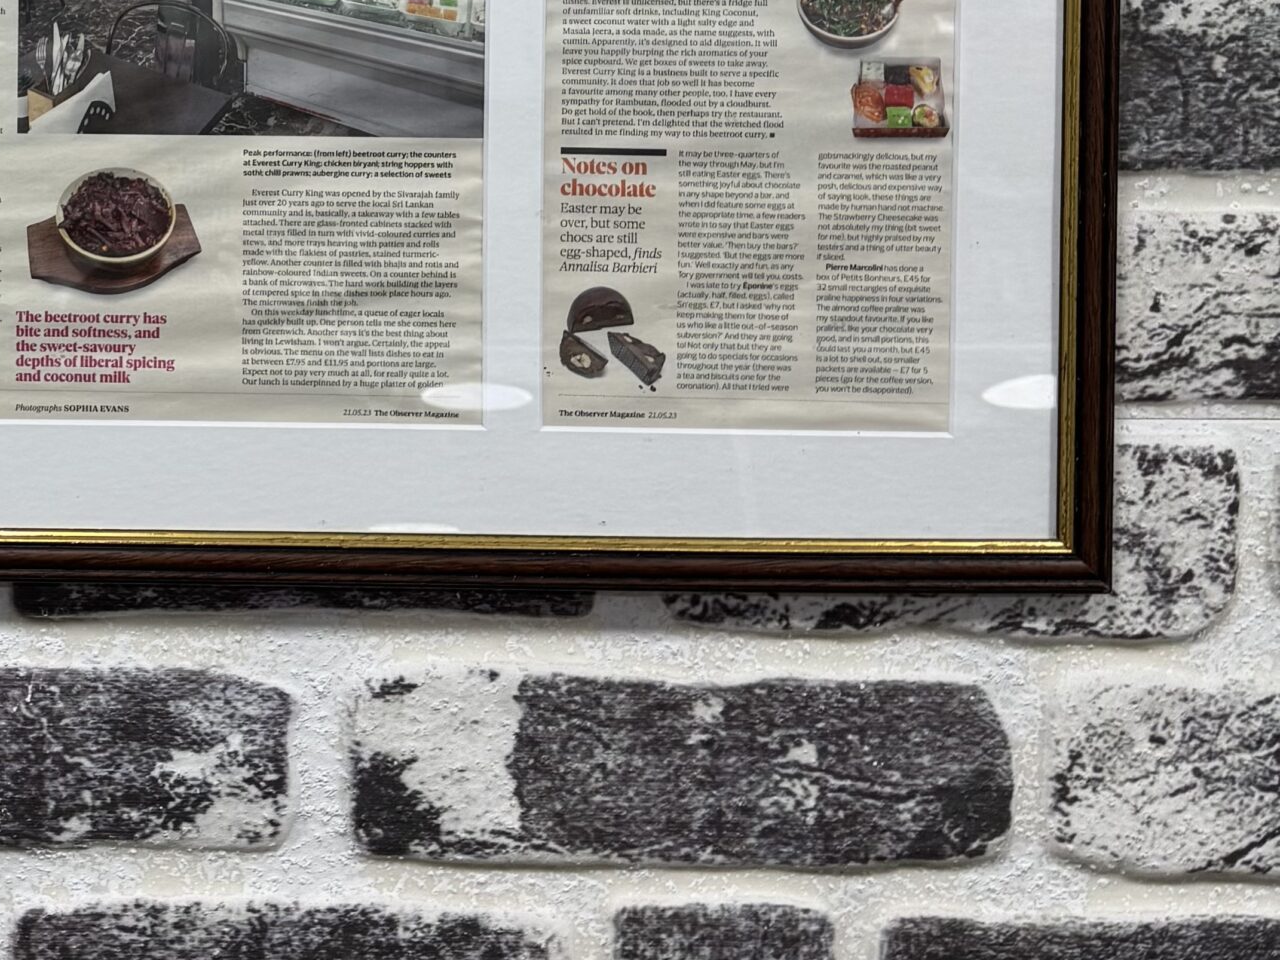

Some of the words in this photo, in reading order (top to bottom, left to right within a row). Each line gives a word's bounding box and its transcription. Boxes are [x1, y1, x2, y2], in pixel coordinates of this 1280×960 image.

[243, 149, 262, 158] Peak
[313, 150, 335, 159] (from
[335, 150, 352, 159] left)
[352, 150, 386, 159] beetroot
[386, 152, 409, 161] curry;
[409, 151, 423, 159] the
[562, 157, 618, 175] Notes
[621, 162, 648, 175] on
[560, 178, 657, 198] chocolate
[560, 203, 598, 214] Easter
[600, 205, 626, 217] may
[628, 204, 642, 215] be
[560, 219, 588, 229] over,
[590, 217, 611, 229] but
[613, 220, 646, 230] some
[560, 231, 594, 243] chocs
[596, 235, 615, 244] are
[617, 232, 638, 244] still
[560, 246, 632, 260] egg-shaped,
[632, 247, 662, 261] finds
[559, 261, 609, 272] Annalisa
[612, 262, 658, 274] Barbieri
[15, 310, 42, 323] The
[45, 311, 101, 324] beetroot
[103, 314, 141, 327] curry
[143, 312, 168, 324] has
[15, 325, 41, 338] bite
[44, 326, 69, 338] and
[72, 326, 132, 340] softness,
[134, 327, 160, 339] and
[15, 340, 37, 352] the
[40, 341, 136, 356] sweet-savoury
[15, 354, 62, 369] depths
[63, 355, 78, 367] of
[80, 356, 124, 369] liberal
[126, 356, 175, 372] spicing
[15, 370, 41, 382] and
[44, 372, 97, 383] coconut
[99, 371, 131, 384] milk
[15, 403, 63, 414] Photographs
[63, 404, 99, 413] SOPHIA
[99, 405, 130, 413] EVANS
[374, 409, 389, 417] The
[389, 409, 424, 418] Observer
[424, 411, 460, 420] Magazine
[574, 410, 609, 418] Observer
[609, 411, 646, 420] Magazine
